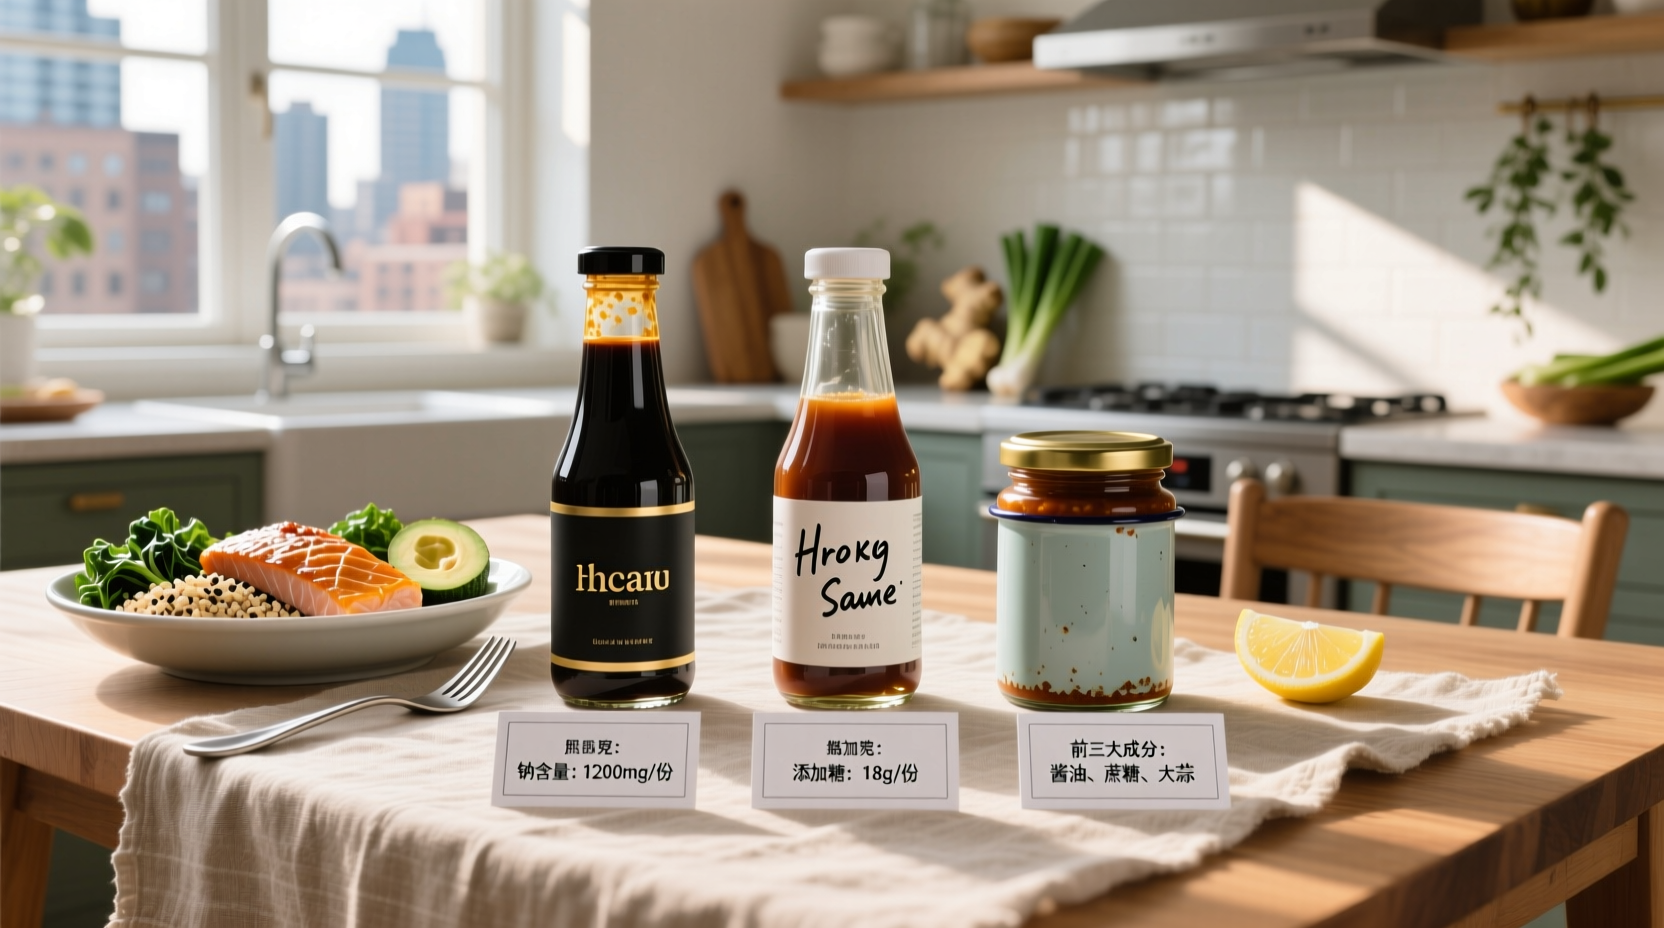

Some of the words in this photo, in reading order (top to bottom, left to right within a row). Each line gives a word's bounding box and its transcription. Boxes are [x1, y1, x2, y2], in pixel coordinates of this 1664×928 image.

[1071, 739, 1164, 758] 前三大成分：
